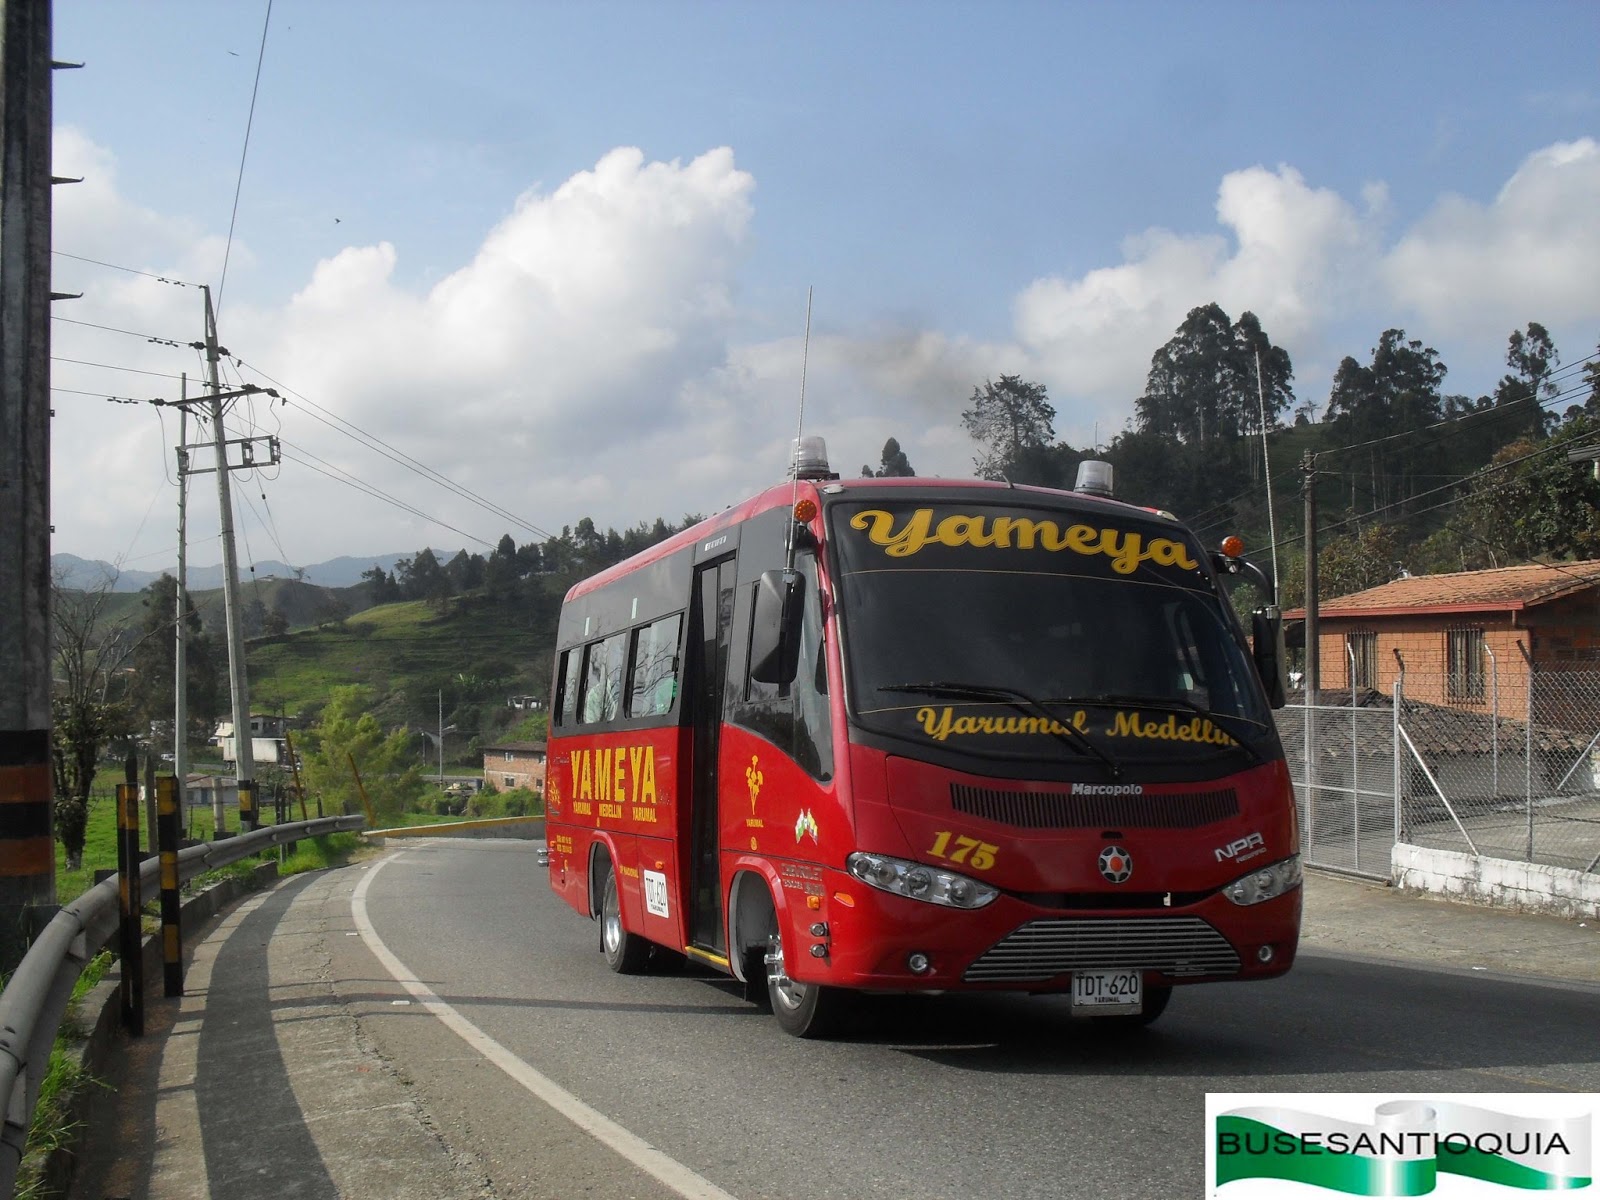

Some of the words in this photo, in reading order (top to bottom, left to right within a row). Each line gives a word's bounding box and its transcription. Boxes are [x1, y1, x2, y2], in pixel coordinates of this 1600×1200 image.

[849, 508, 1200, 575] Yameya
[916, 707, 1090, 741] Yarumal
[570, 746, 656, 804] YAMEYA
[1071, 783, 1143, 797] Marcopolo
[926, 831, 999, 870] 175
[1214, 832, 1264, 862] NPR
